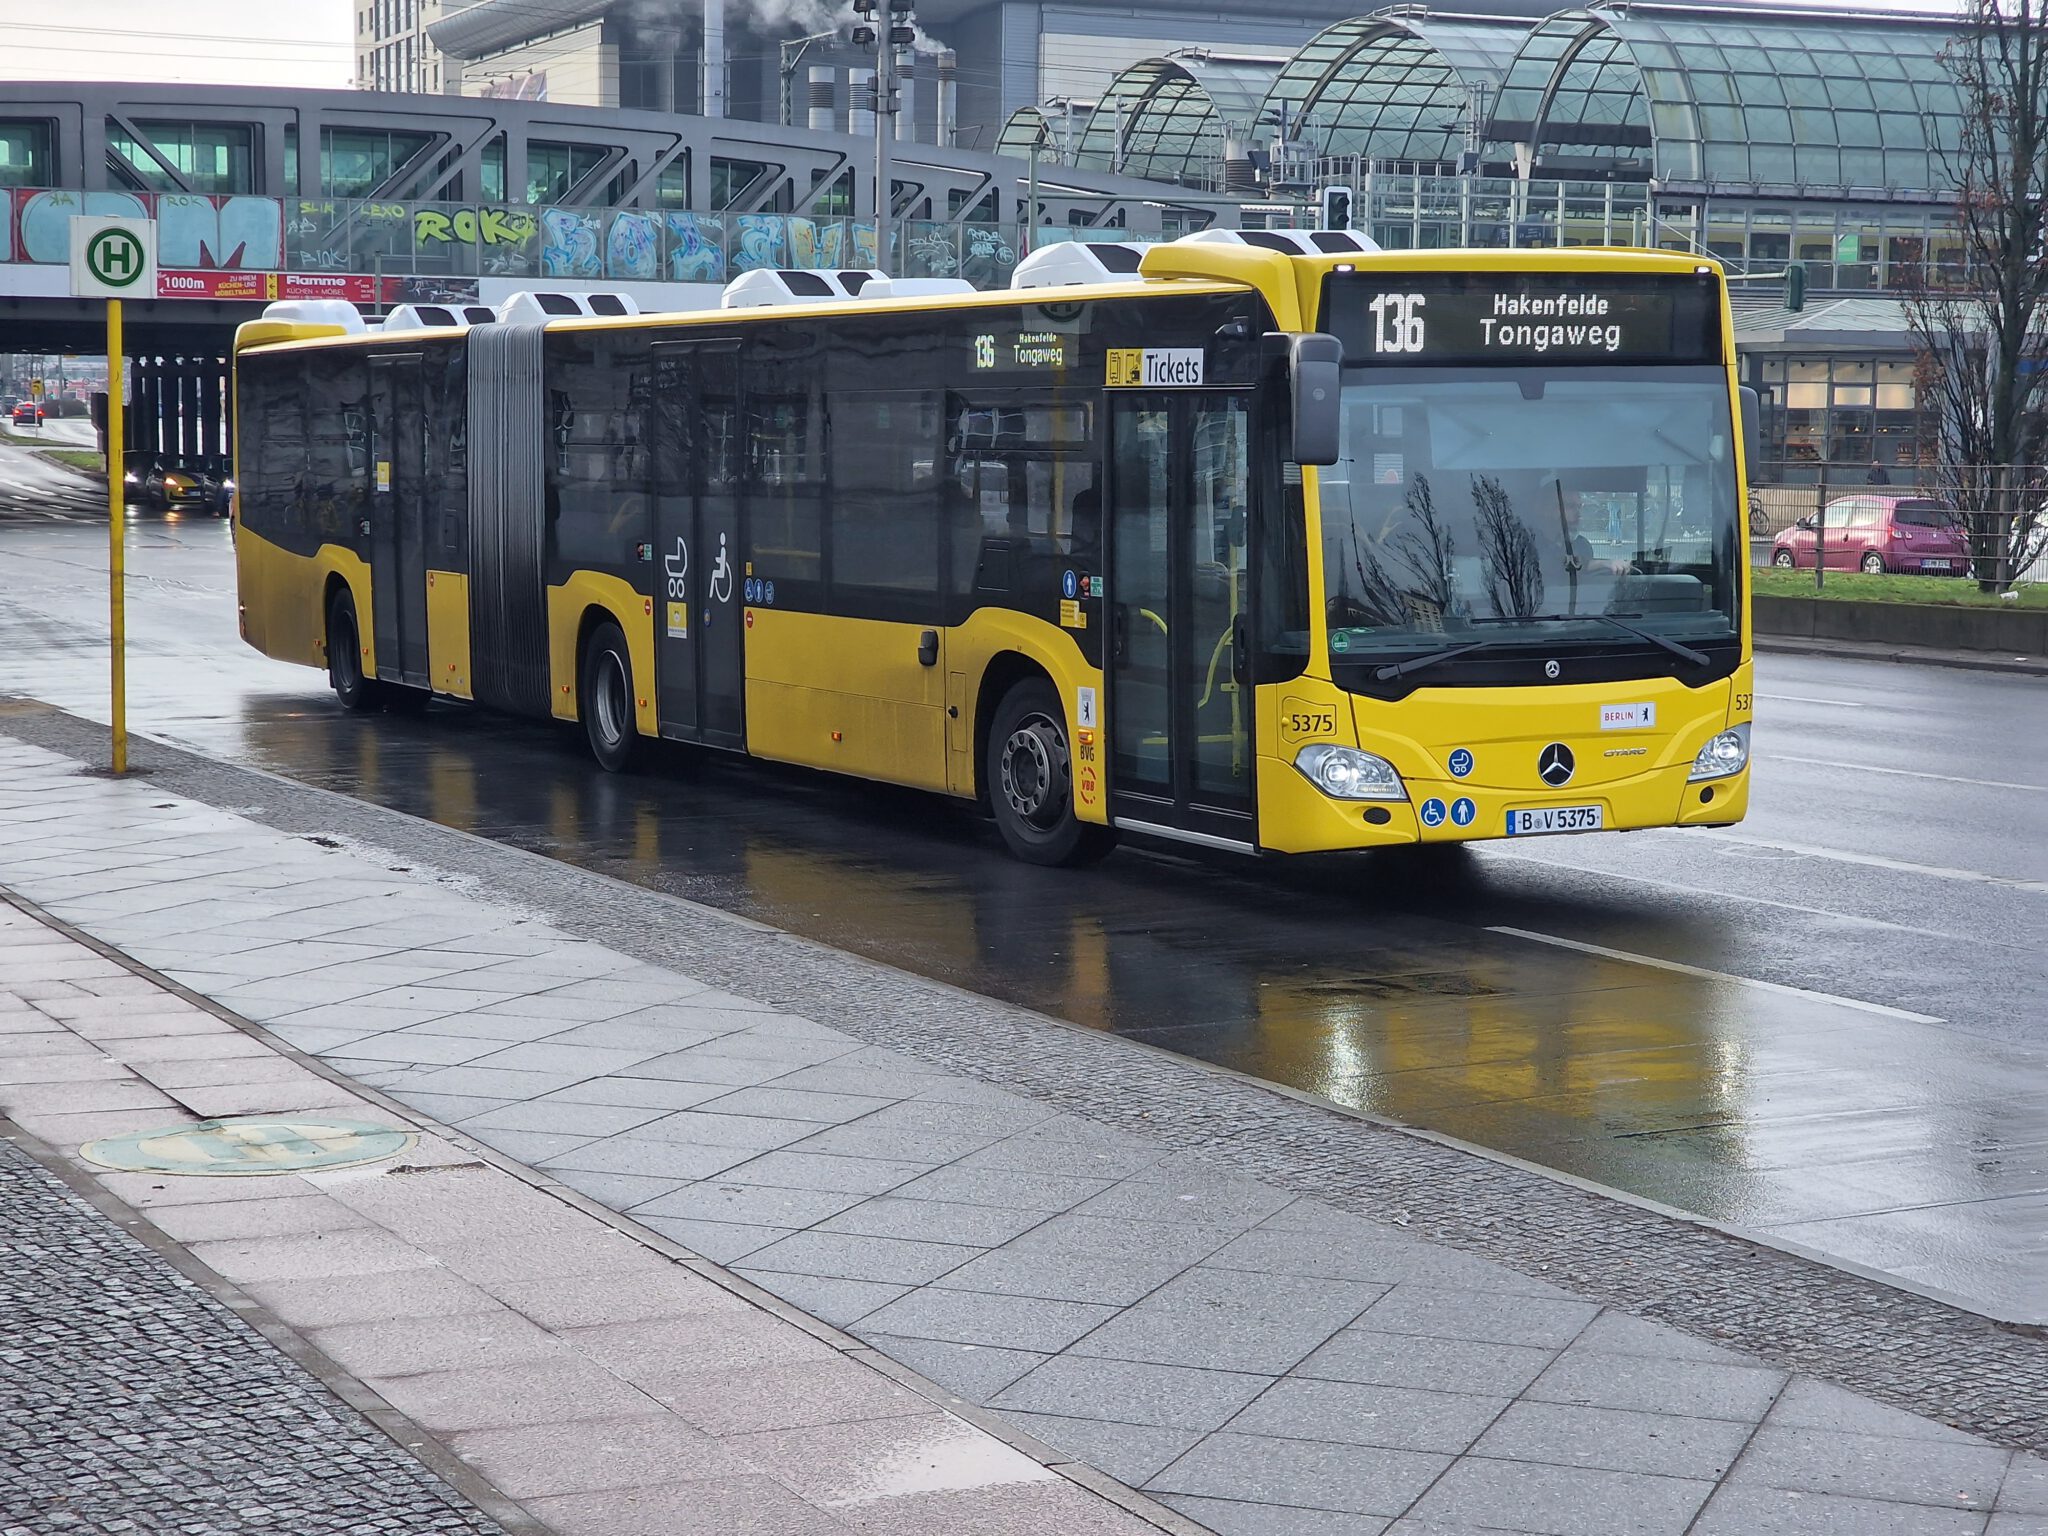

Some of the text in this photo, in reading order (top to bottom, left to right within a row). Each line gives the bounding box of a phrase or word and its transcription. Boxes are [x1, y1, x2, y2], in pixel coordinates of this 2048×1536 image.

[102, 241, 130, 274] H
[164, 276, 205, 289] 1000m
[286, 275, 346, 286] Flamme
[1493, 294, 1609, 317] Hakenfelde
[1368, 293, 1426, 353] 136
[1019, 332, 1057, 343] Hakenfelde
[1479, 318, 1621, 352] Tongaweg
[975, 334, 995, 368] 136
[1013, 344, 1063, 366] Tongaweg
[1146, 352, 1199, 383] Tickets
[1735, 693, 1752, 711] 537
[1292, 714, 1333, 732] 5375
[1604, 711, 1634, 721] BERLIN
[1080, 745, 1095, 762] BVG
[1522, 812, 1533, 830] B
[1544, 811, 1554, 829] V
[1557, 808, 1596, 828] 5375
